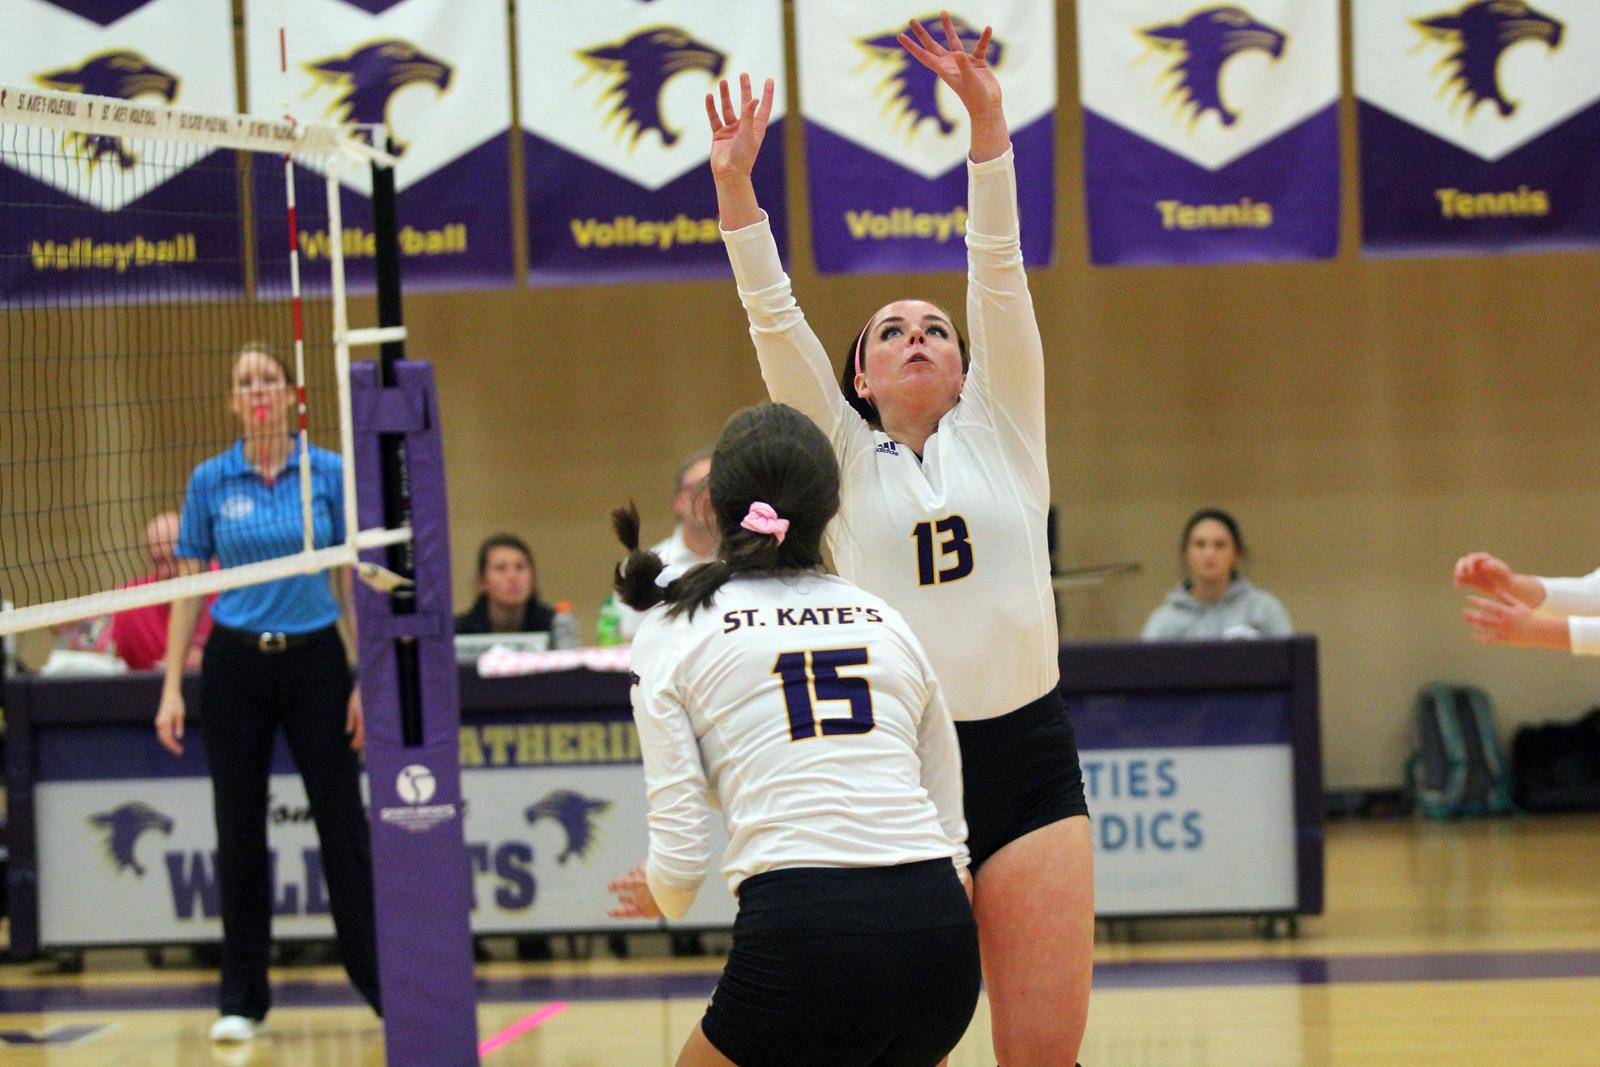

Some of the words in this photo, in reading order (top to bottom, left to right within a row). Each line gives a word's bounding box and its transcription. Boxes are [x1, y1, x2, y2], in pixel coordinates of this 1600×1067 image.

[1156, 198, 1272, 229] Tennis
[1435, 186, 1549, 218] Tennis
[299, 222, 467, 260] Vlleball
[570, 213, 721, 250] Volleyba
[846, 206, 968, 243] Volleyb
[911, 513, 977, 588] 13
[723, 608, 766, 634] ST.
[777, 606, 883, 627] KATE'S
[772, 646, 876, 743] 15
[1082, 758, 1179, 799] TIES
[1100, 811, 1205, 851] DICS
